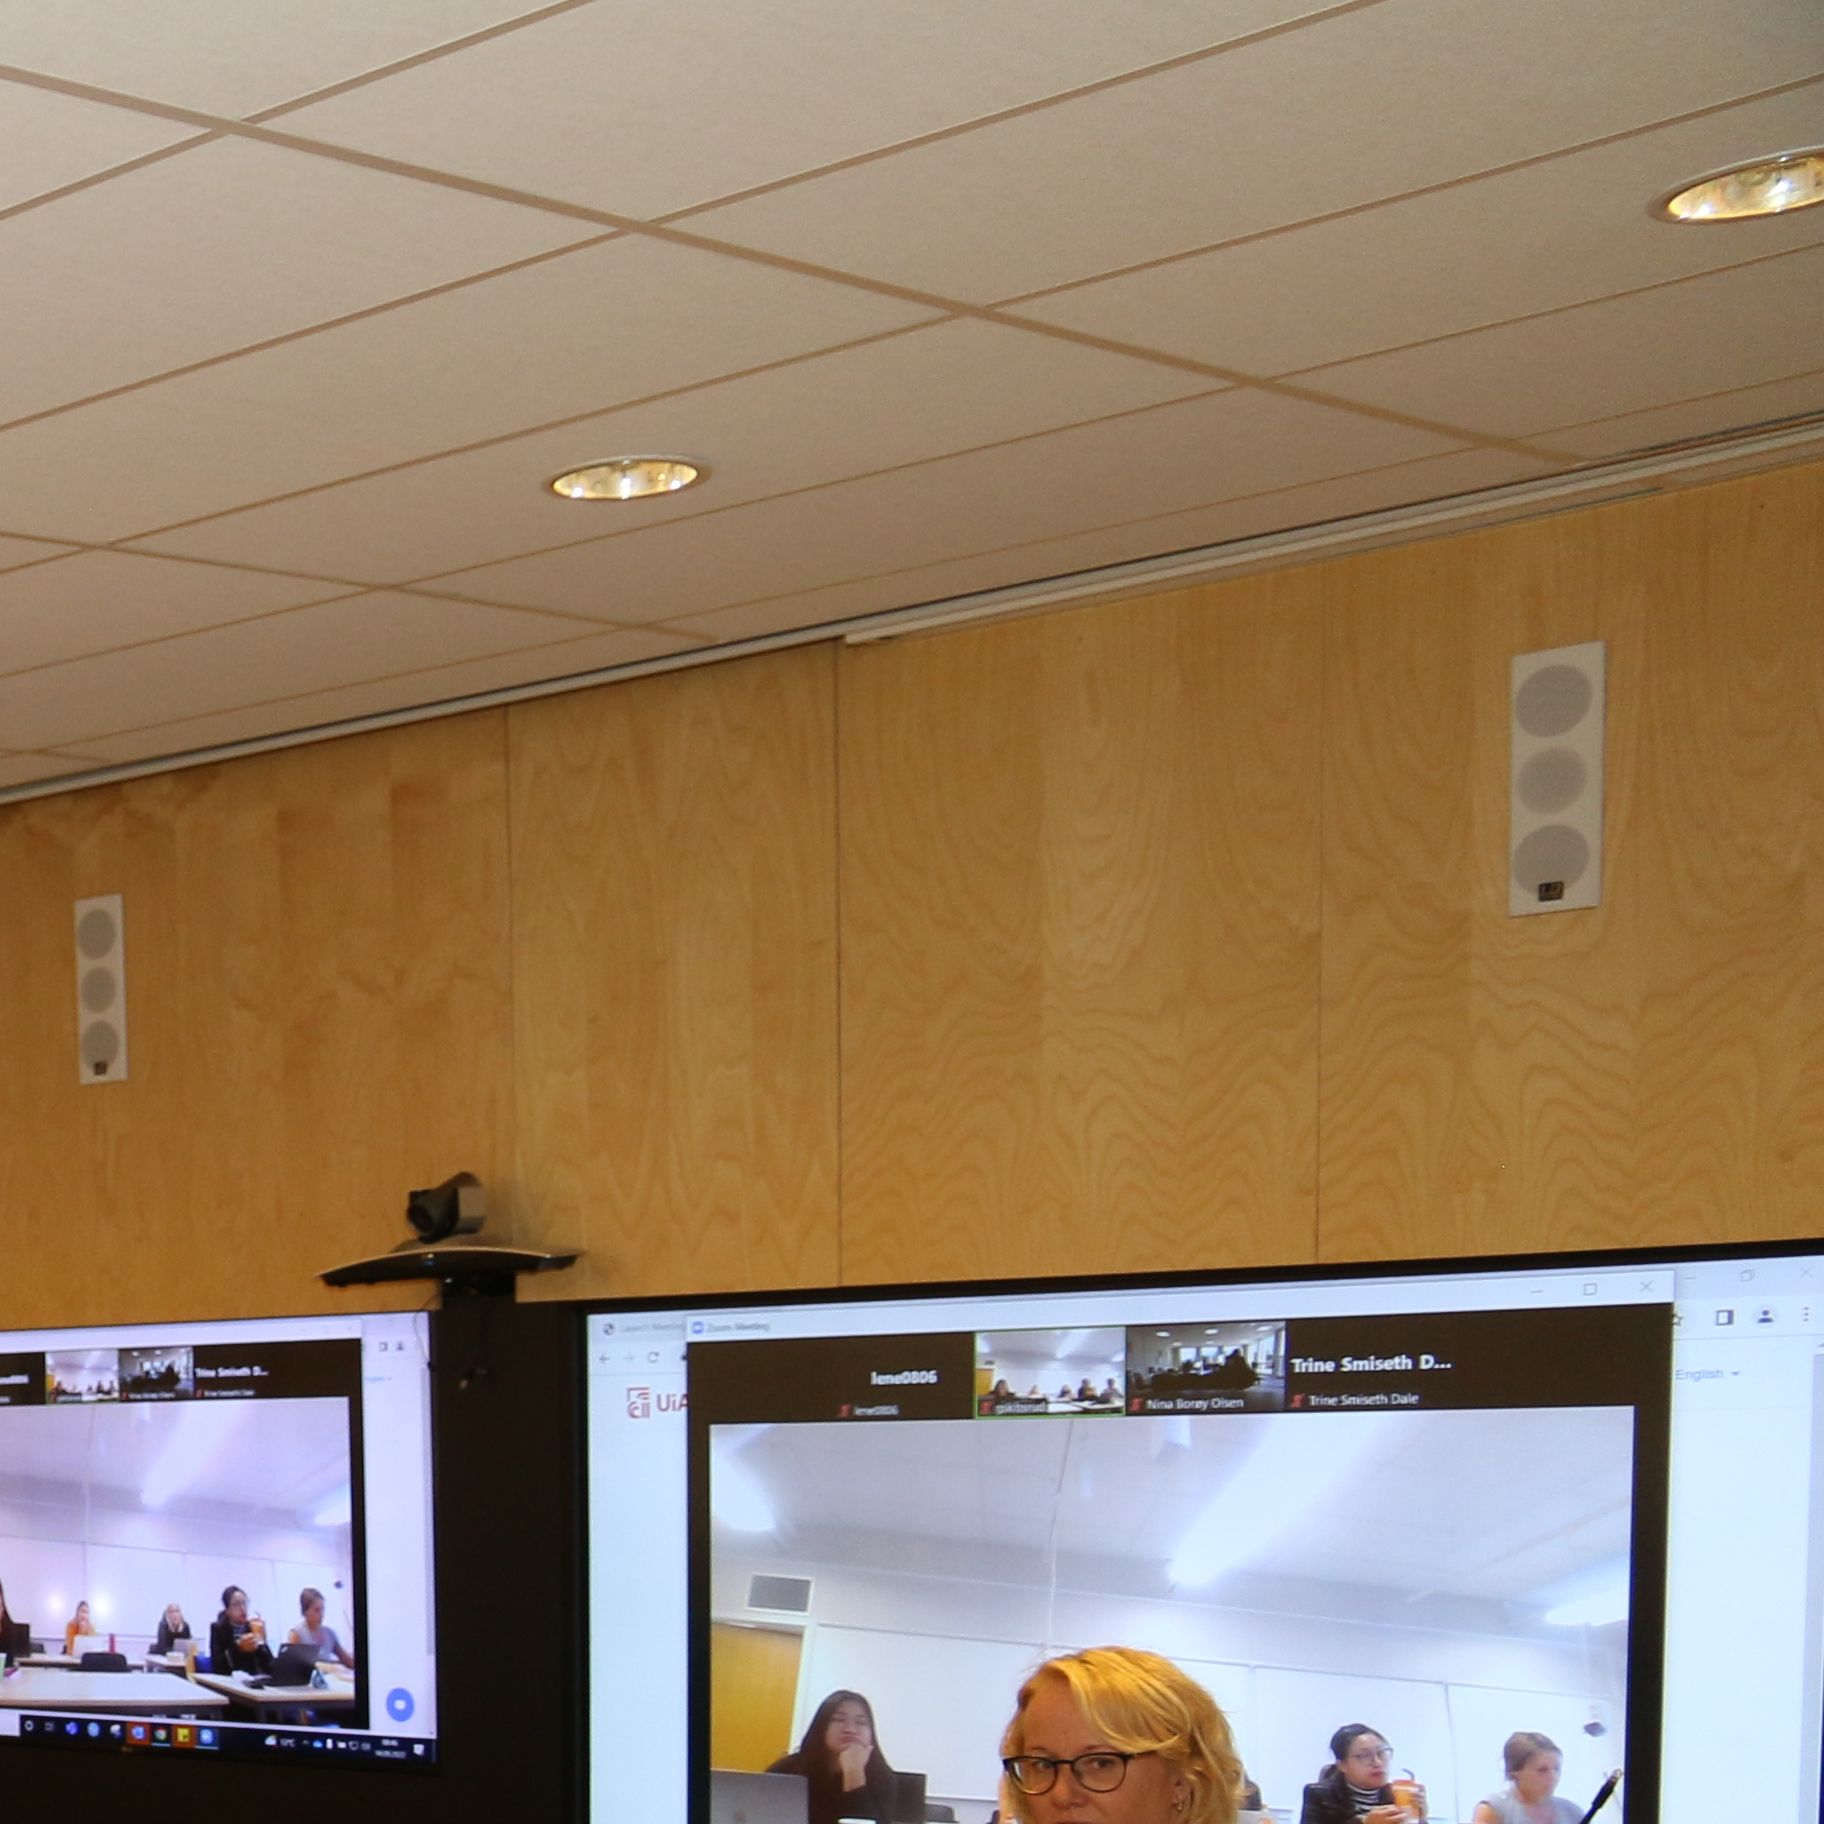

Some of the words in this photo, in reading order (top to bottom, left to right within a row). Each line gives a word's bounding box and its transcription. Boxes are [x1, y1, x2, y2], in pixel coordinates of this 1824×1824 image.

[1290, 1358, 1336, 1373] Trine
[1340, 1354, 1412, 1372] Smiseth
[870, 1369, 938, 1386] lene0806
[1676, 1368, 1724, 1382] English
[1147, 1399, 1174, 1410] Nina
[1212, 1396, 1244, 1409] Olsen
[1309, 1394, 1338, 1407] Trine
[1341, 1392, 1388, 1406] Smiseth
[1391, 1391, 1419, 1405] Dale
